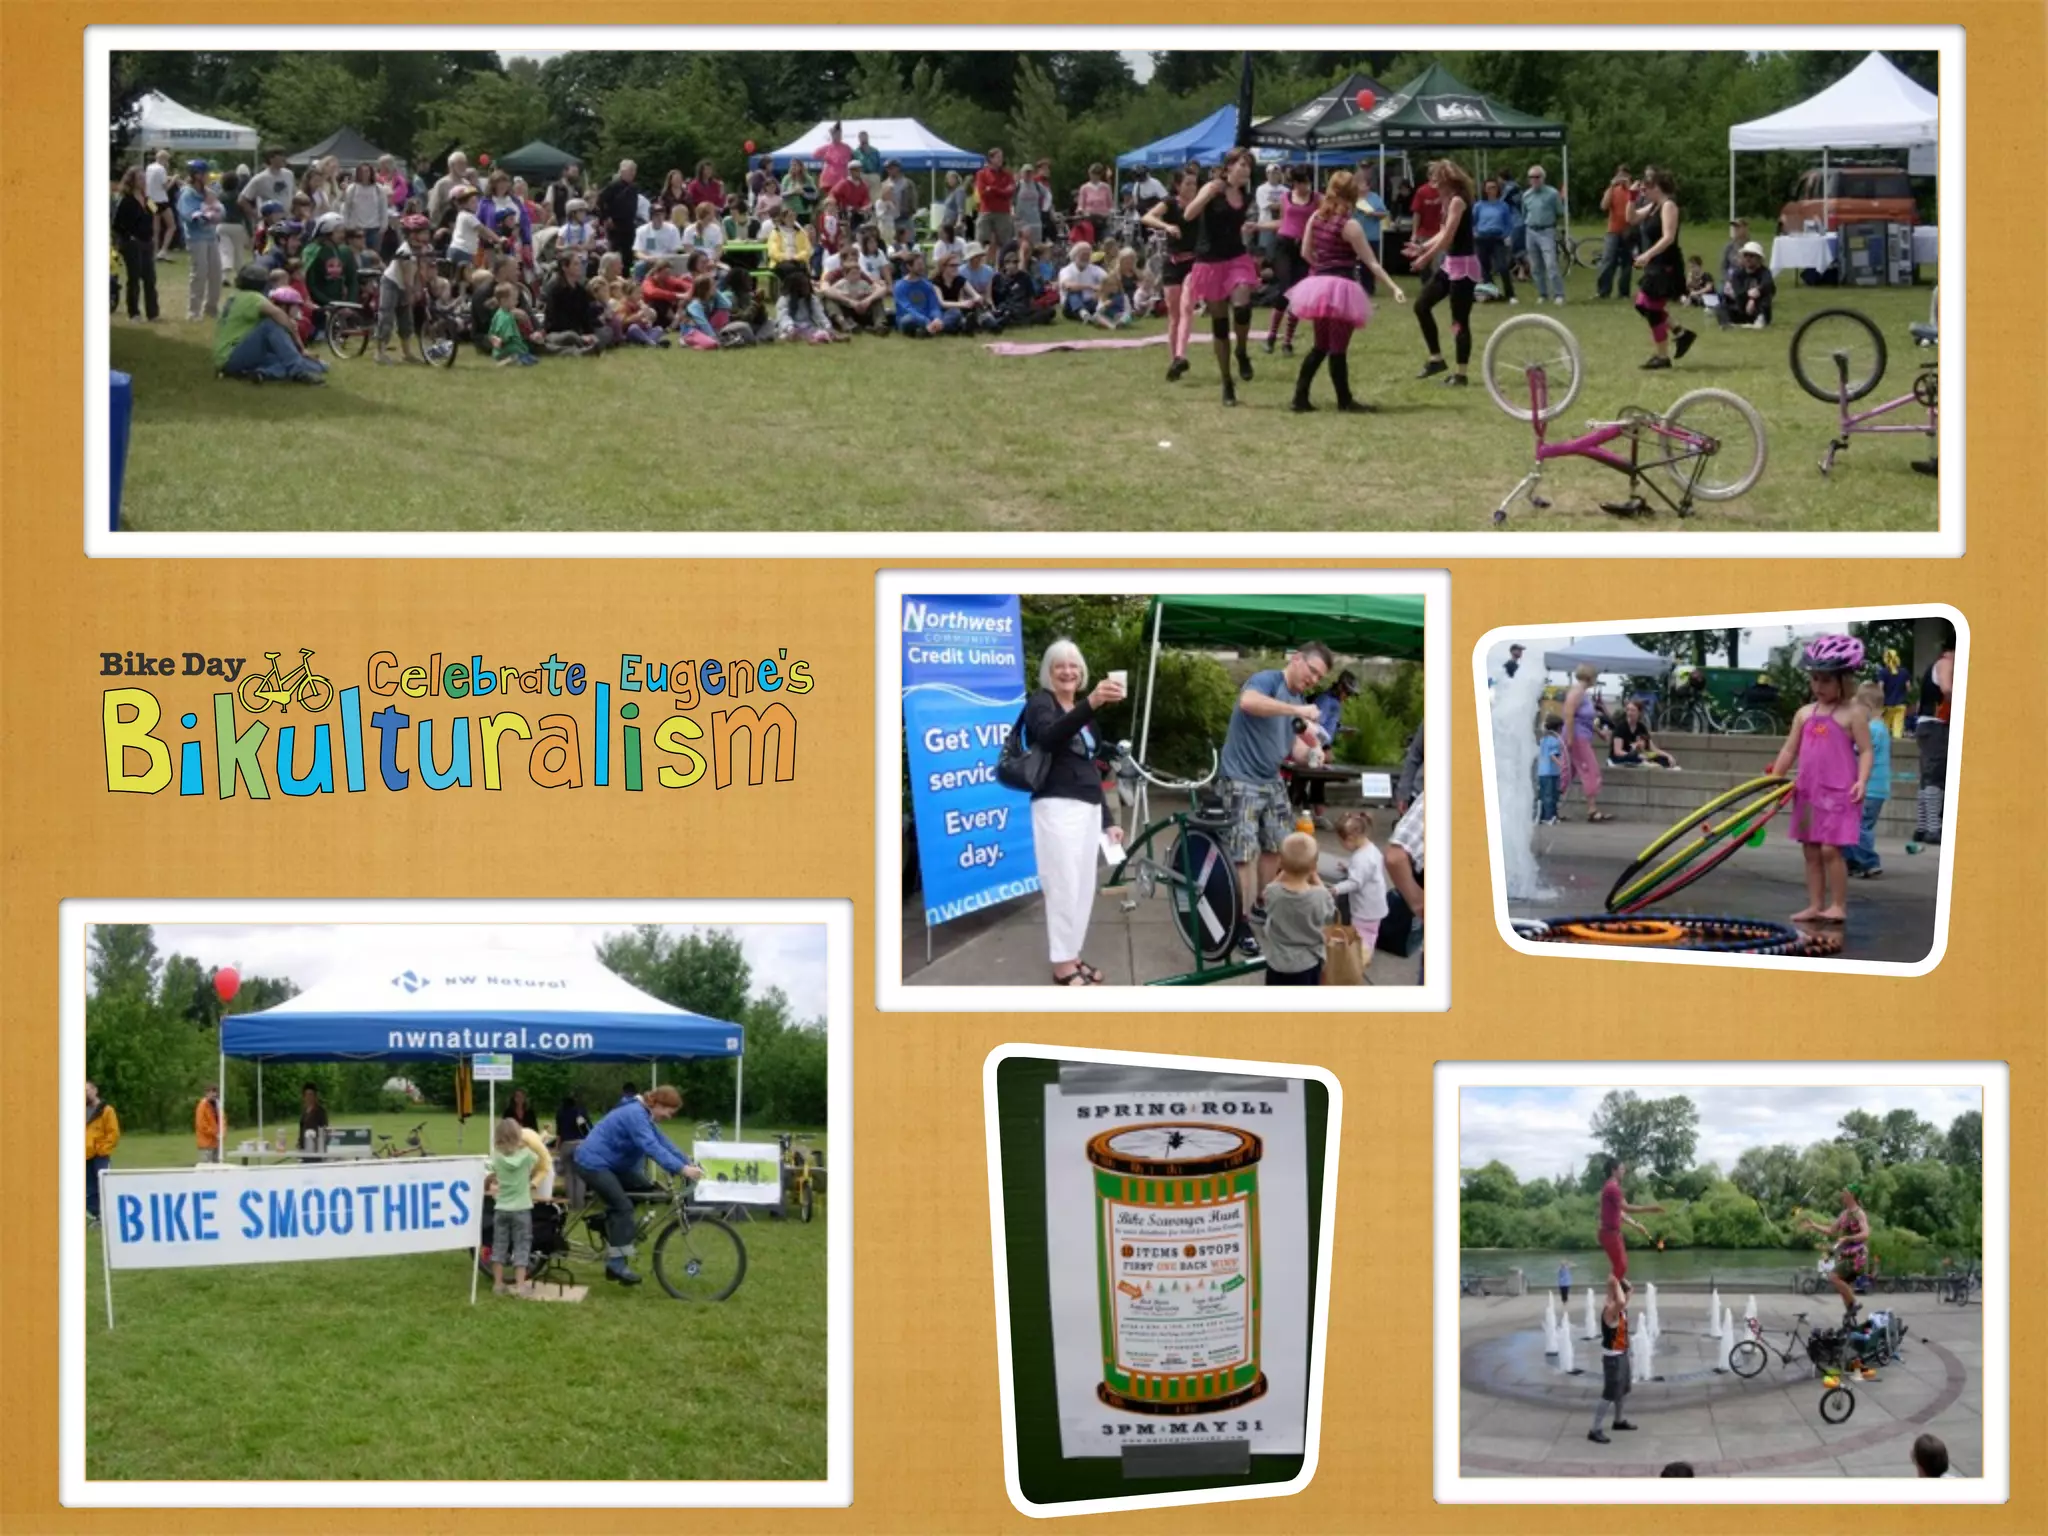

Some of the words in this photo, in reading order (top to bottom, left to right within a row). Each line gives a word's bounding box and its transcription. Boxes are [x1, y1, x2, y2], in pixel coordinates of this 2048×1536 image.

[903, 601, 1013, 633] Northwest
[908, 647, 964, 665] Credit
[969, 650, 1015, 666] Union
[924, 727, 970, 753] Get
[975, 723, 1012, 747] VIP
[929, 762, 997, 791] servic
[945, 807, 1008, 834] Every
[959, 843, 1004, 868] day.
[445, 975, 477, 986] NW
[487, 975, 569, 989] Natural
[388, 1028, 594, 1049] nwnatural.com
[1077, 1103, 1188, 1119] SPRING
[1201, 1101, 1274, 1115] ROLL
[117, 1190, 221, 1244] BIKE
[239, 1180, 472, 1240] SMOOTHIES
[1136, 1247, 1179, 1258] ITEMS
[1198, 1243, 1240, 1257] STOPS
[1102, 1423, 1155, 1436] 3PM
[1169, 1420, 1228, 1434] MAY
[1236, 1419, 1264, 1431] 31
